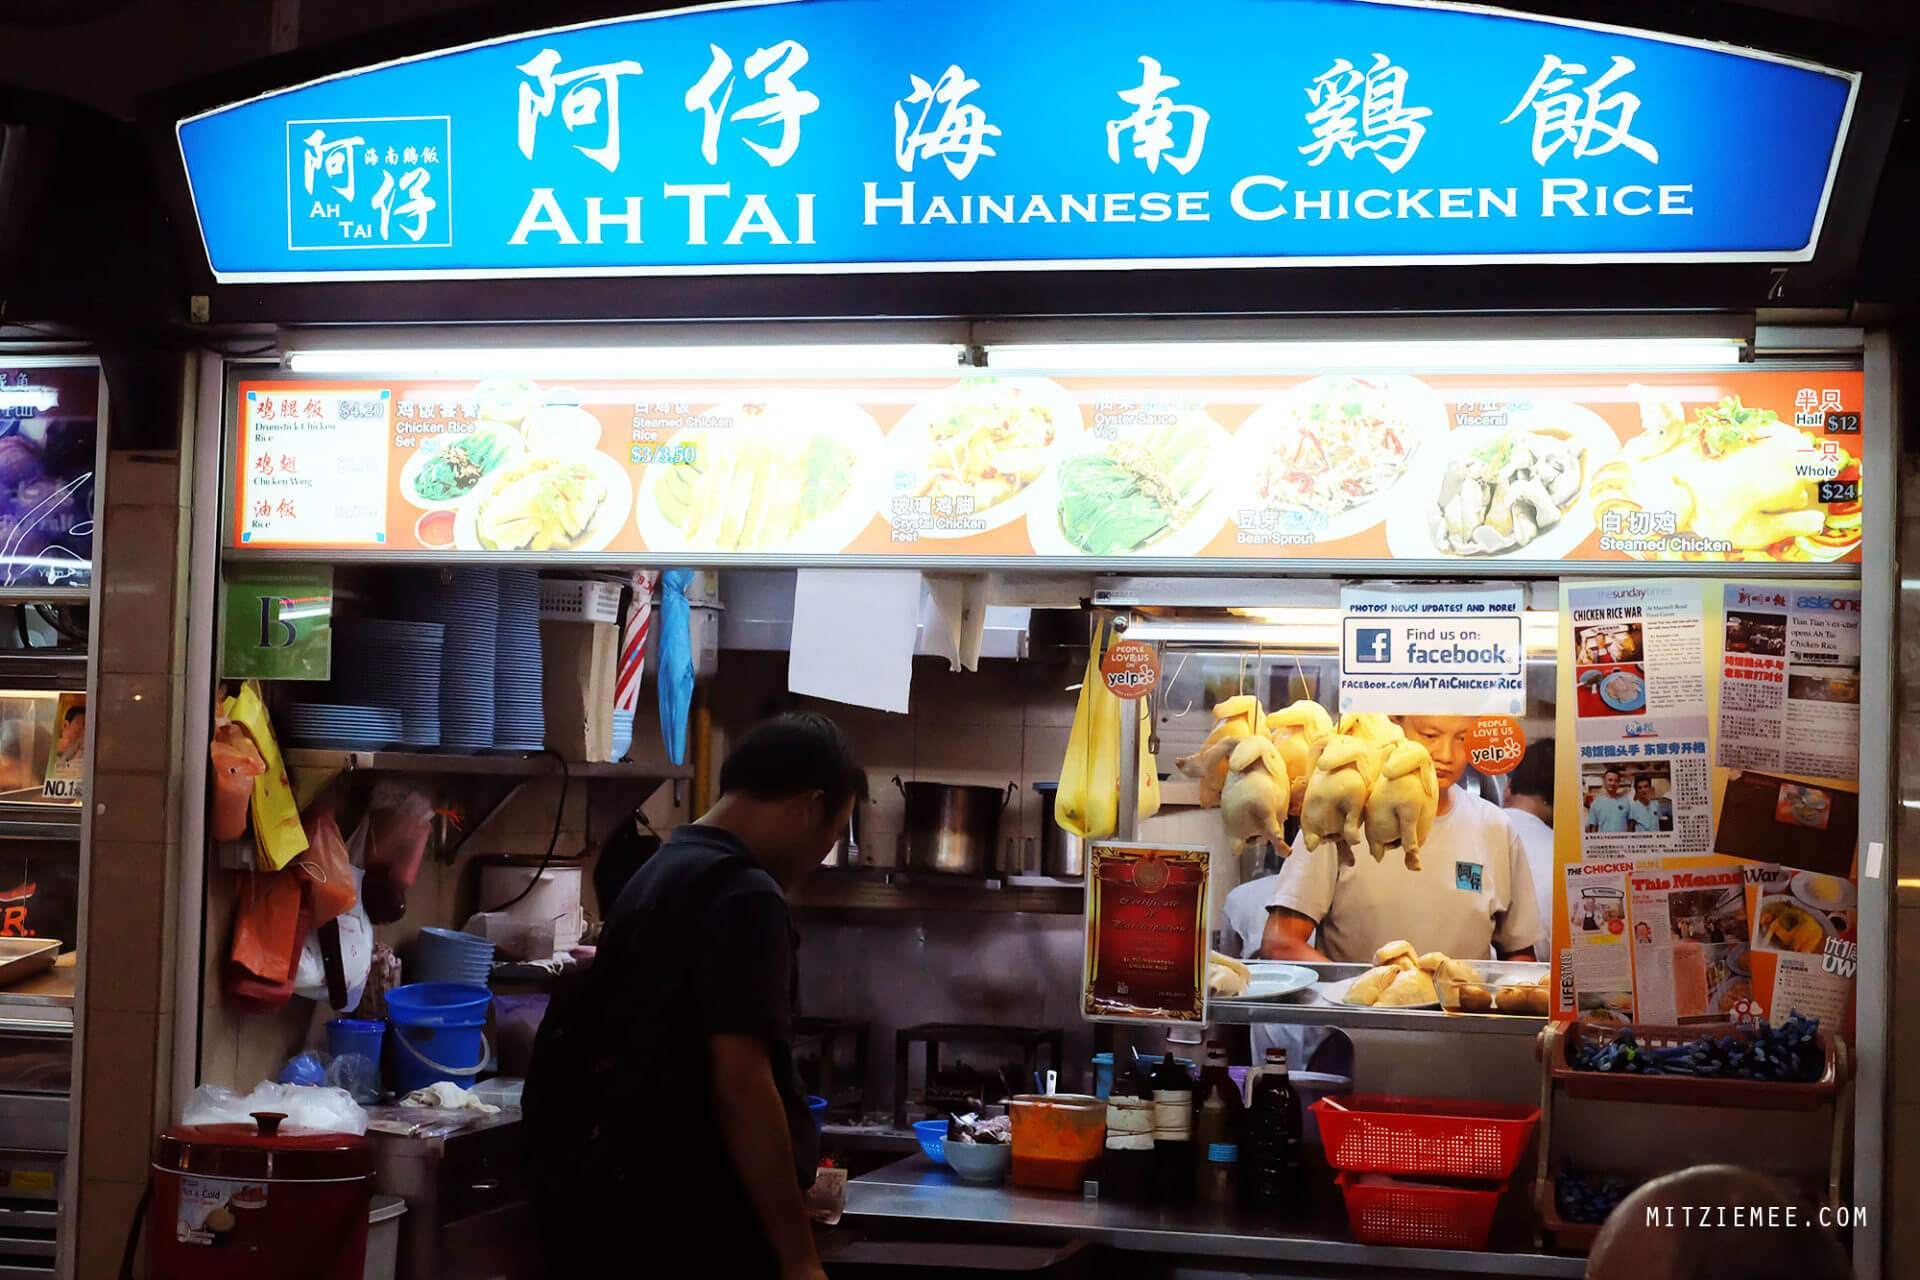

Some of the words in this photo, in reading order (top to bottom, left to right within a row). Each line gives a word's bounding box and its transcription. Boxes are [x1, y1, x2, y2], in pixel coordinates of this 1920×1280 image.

[309, 201, 341, 219] AH
[508, 187, 644, 246] AH
[663, 182, 818, 246] TAI
[862, 179, 1210, 226] HAINANESE
[1229, 174, 1517, 222] CHICKEN
[1540, 178, 1694, 218] RICE
[338, 220, 373, 239] TAI
[1795, 387, 1843, 413] 半只
[632, 415, 684, 429] Steamed
[1455, 412, 1508, 427] Visceral
[1795, 413, 1823, 426] Half
[1827, 415, 1858, 432] $12
[395, 420, 445, 434] Chicken
[448, 420, 477, 434] Rice
[394, 434, 416, 448] Set
[632, 428, 658, 442] Rice
[1795, 464, 1837, 477] Whole
[1821, 482, 1856, 500] $24
[936, 516, 987, 530] Chicken
[1601, 510, 1677, 536] 白切鸡
[1271, 531, 1315, 546] Sprout
[1599, 536, 1667, 552] Steamed
[1669, 536, 1733, 553] Chicken
[1350, 603, 1387, 613] PHOTOS!
[1422, 603, 1463, 612] UPDATES!
[1466, 603, 1485, 612] AND
[1489, 603, 1516, 612] MORE!
[1573, 608, 1606, 622] CHICKEN
[1606, 606, 1623, 620] RICE
[1624, 605, 1642, 618] WAR
[1406, 628, 1435, 641] Find
[1440, 631, 1455, 641] us
[1460, 630, 1480, 641] on:
[1116, 646, 1145, 654] PEOPLE
[1407, 642, 1507, 664] facebook
[1111, 654, 1137, 662] LOVE
[1137, 654, 1149, 662] US
[1107, 670, 1139, 688] yelp
[1477, 719, 1507, 728] PEOPLE
[1473, 727, 1499, 738] LOVE
[1500, 726, 1514, 736] US
[1471, 745, 1505, 764] yelp
[1568, 867, 1582, 876] THE
[1583, 862, 1634, 875] CHICKEN
[1744, 867, 1780, 883] War
[1632, 878, 1671, 891] This
